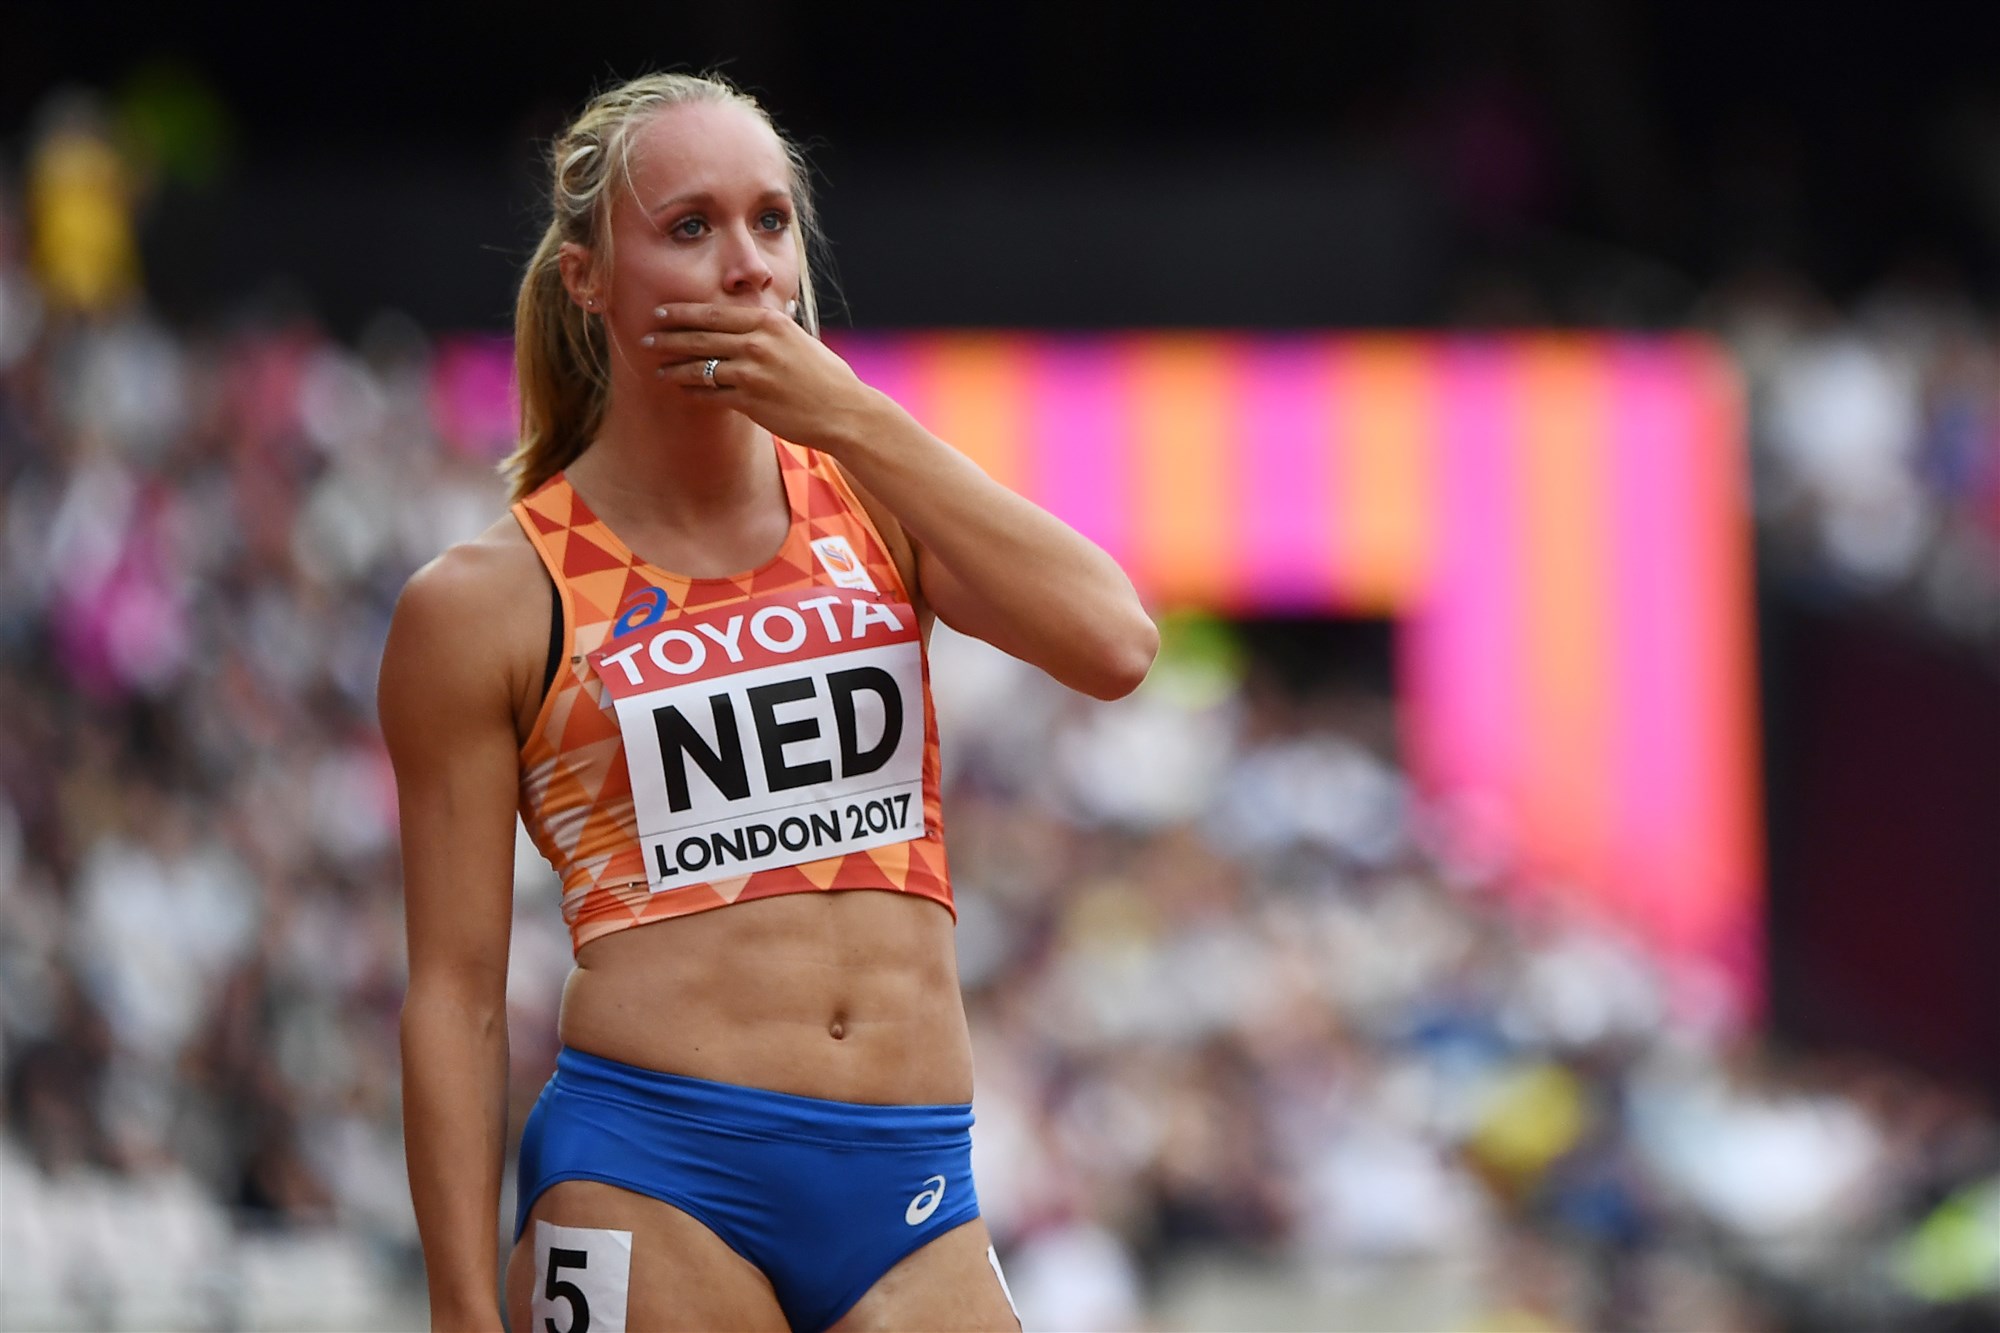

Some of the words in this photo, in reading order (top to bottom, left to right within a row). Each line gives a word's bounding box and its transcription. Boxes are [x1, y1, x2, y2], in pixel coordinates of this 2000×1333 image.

[600, 595, 904, 686] TOYOTA
[652, 666, 903, 813] NED
[655, 810, 842, 877] LONDON
[846, 793, 912, 840] 2017
[545, 1247, 590, 1333] 5
